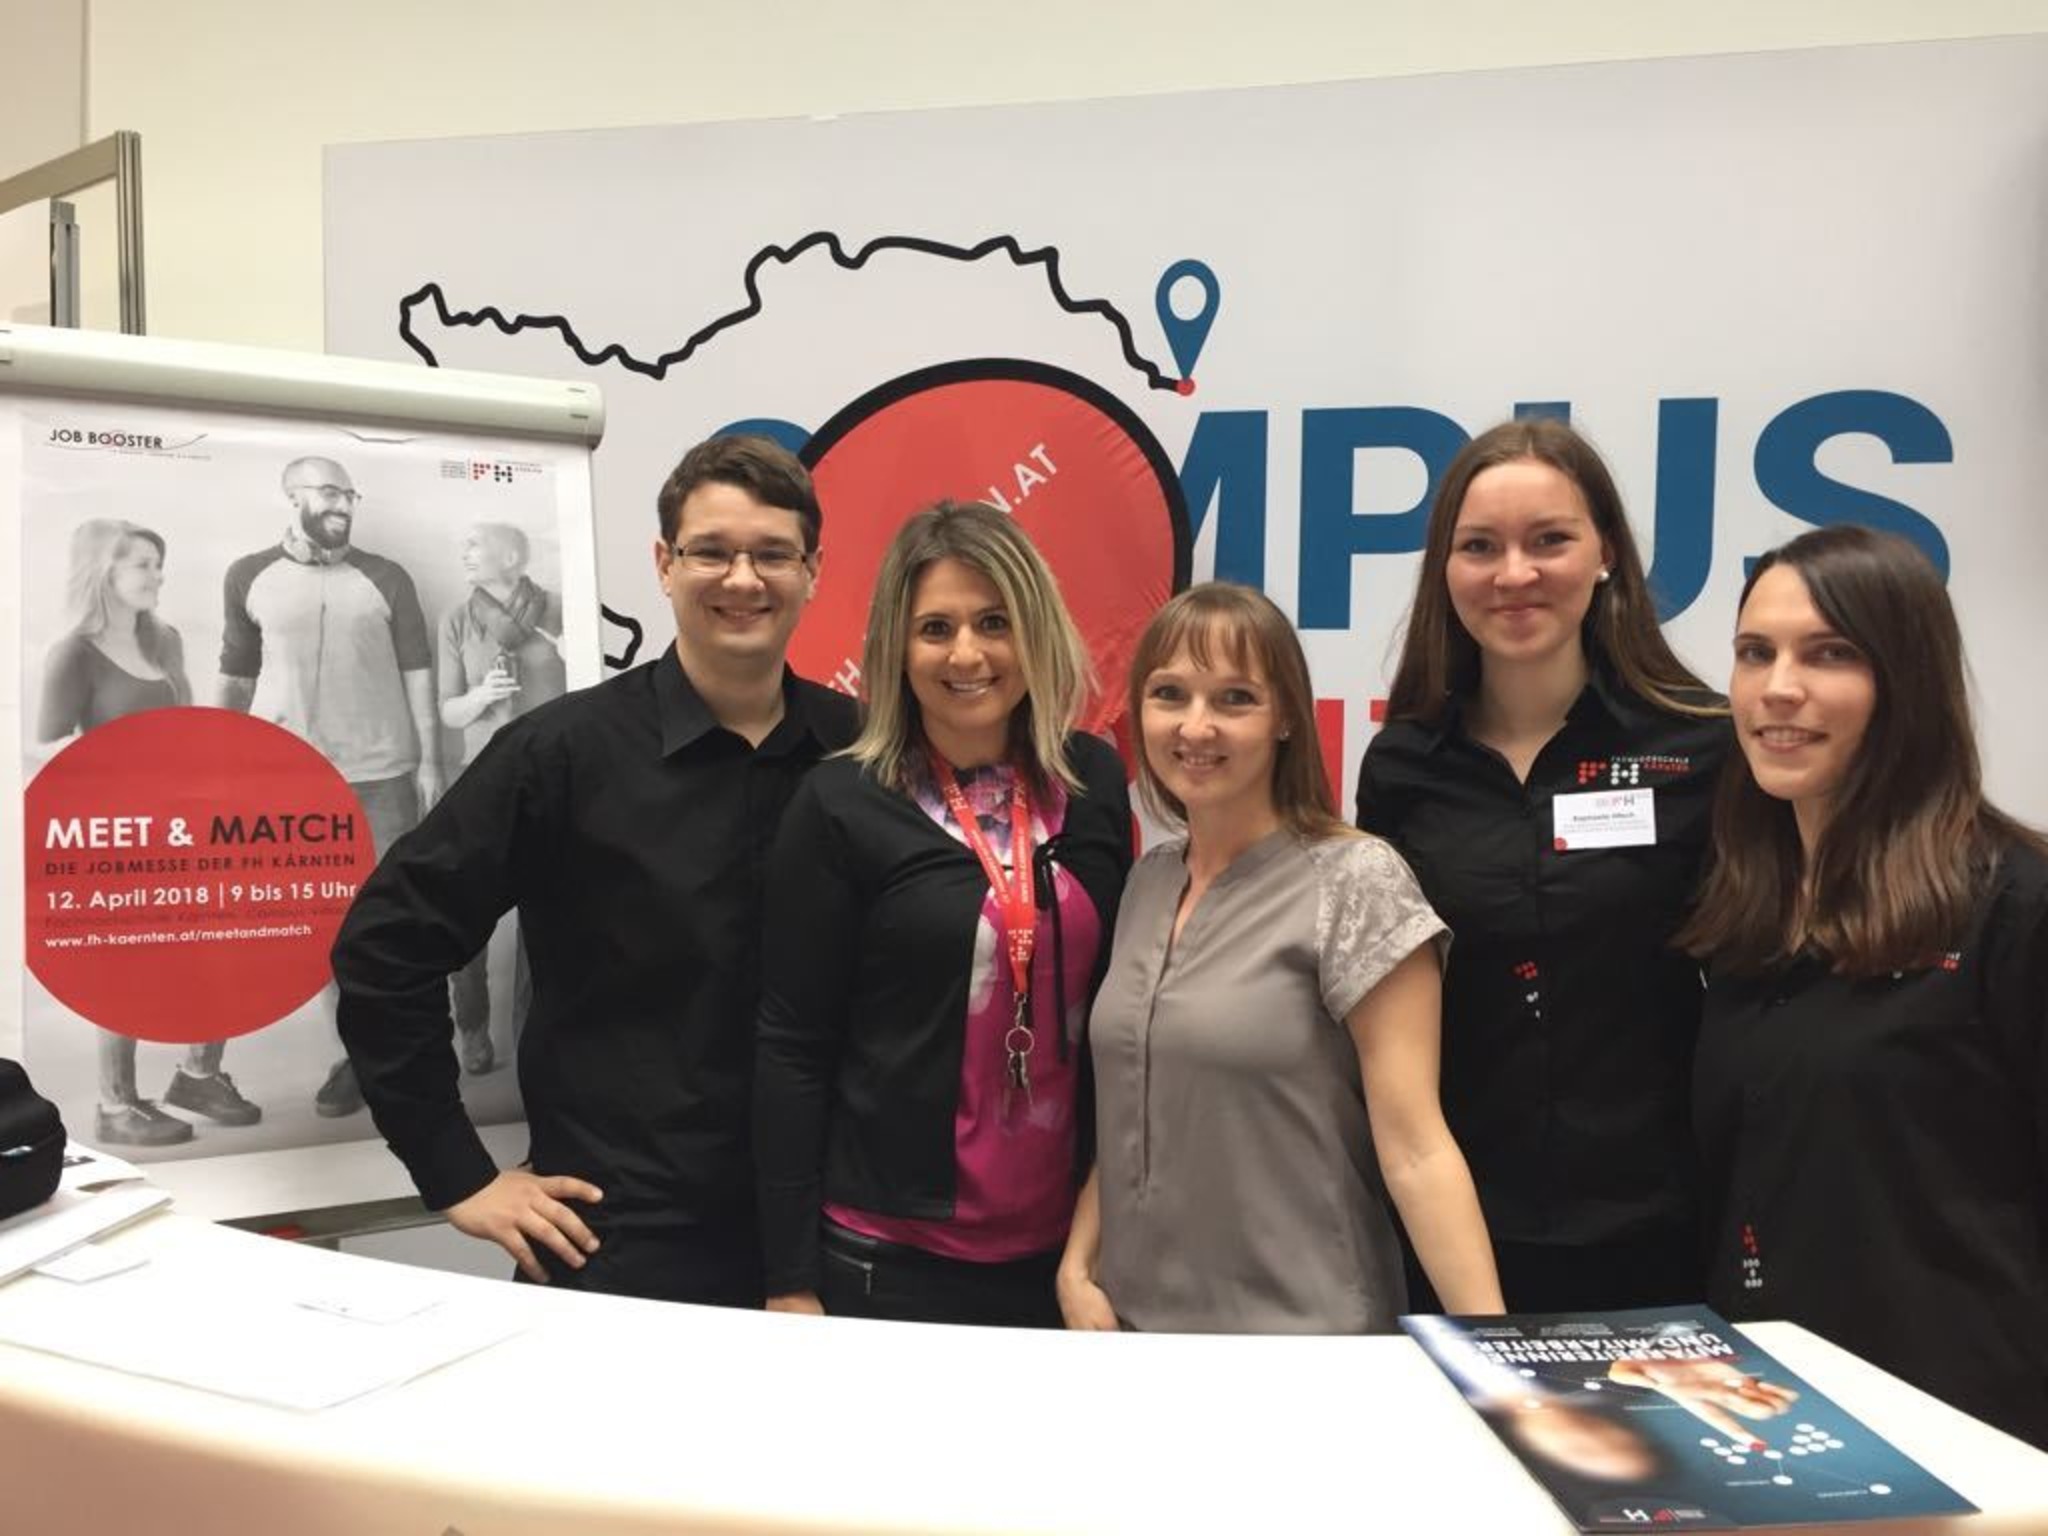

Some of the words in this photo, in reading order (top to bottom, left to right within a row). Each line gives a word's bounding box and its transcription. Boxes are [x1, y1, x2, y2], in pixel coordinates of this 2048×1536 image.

[50, 429, 83, 443] JOB
[87, 431, 163, 449] BOOSTER
[46, 816, 153, 849] MEET
[167, 817, 195, 847] &
[210, 813, 355, 845] MATCH
[46, 862, 77, 876] DIE
[85, 858, 190, 876] JOBMESSE
[198, 857, 233, 872] DER
[241, 856, 264, 870] FH
[47, 891, 81, 910] 12.
[90, 888, 146, 911] April
[153, 886, 209, 905] 2018
[231, 885, 243, 902] 9
[251, 883, 282, 901] bis
[290, 883, 314, 899] 15
[321, 882, 357, 899] Uhr
[45, 924, 313, 948] www.fh-kaernten.at/meetandmatch
